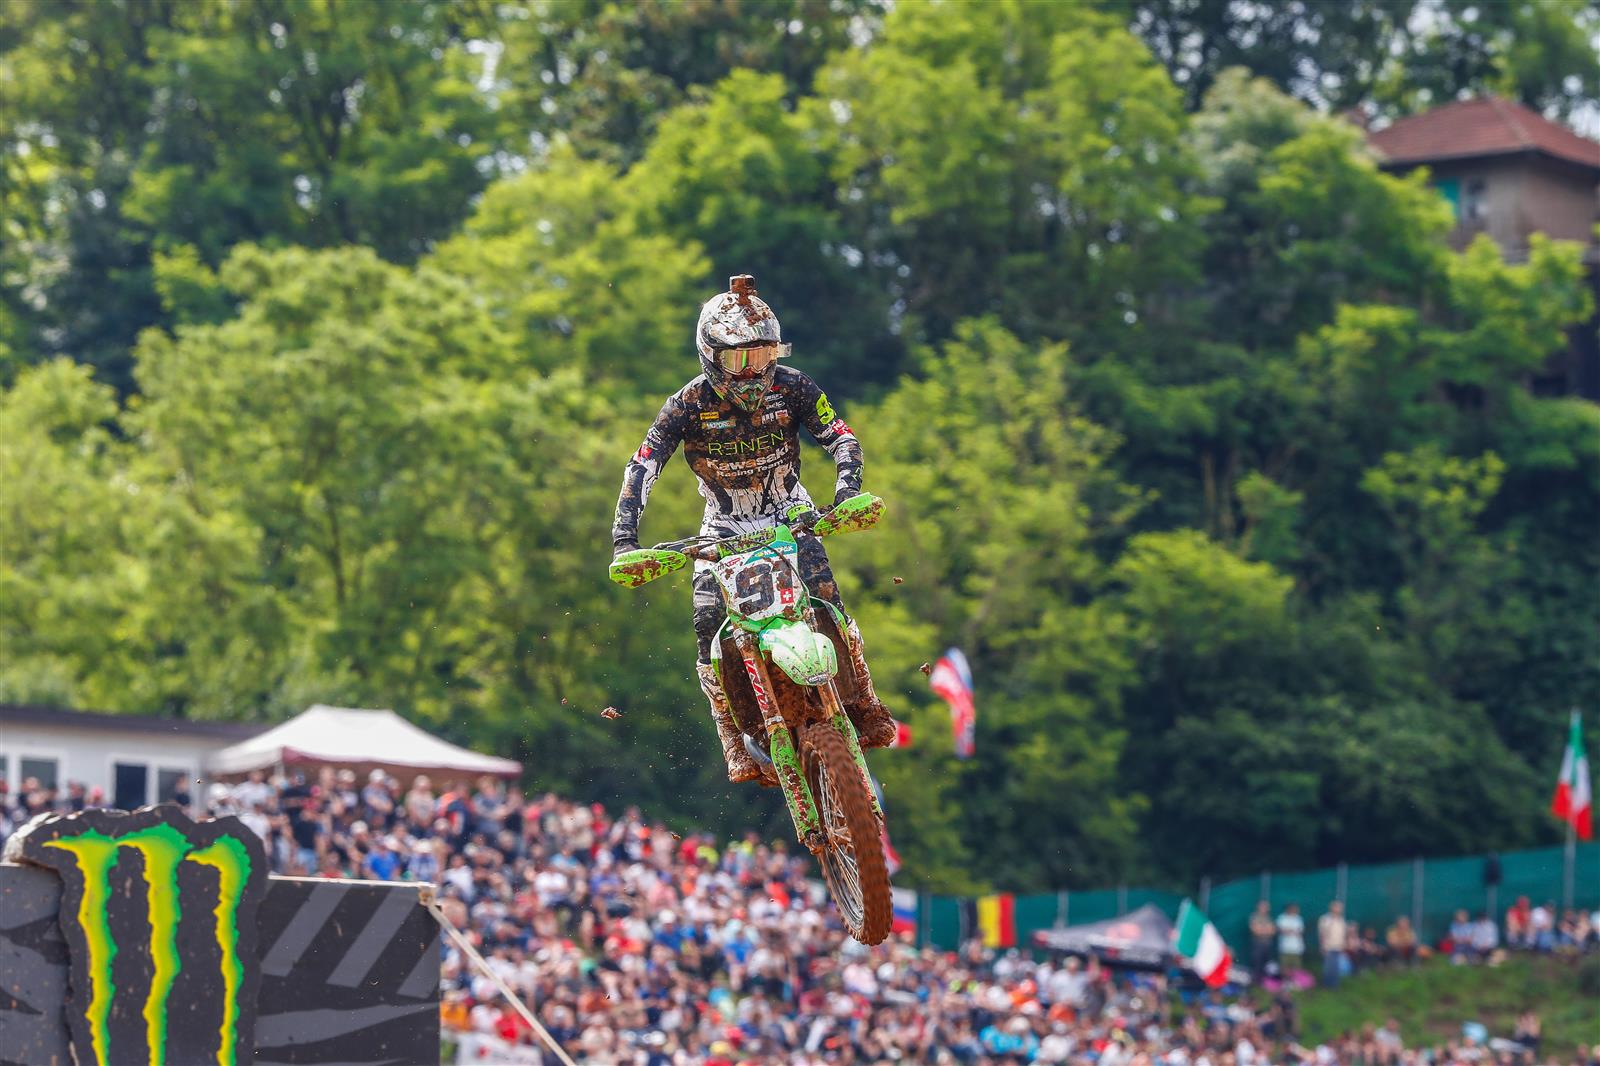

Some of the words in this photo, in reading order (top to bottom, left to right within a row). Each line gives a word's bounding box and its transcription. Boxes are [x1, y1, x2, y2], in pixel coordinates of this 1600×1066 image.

[706, 440, 789, 471] Kawasaki
[756, 459, 784, 472] Team
[735, 559, 794, 616] 91
